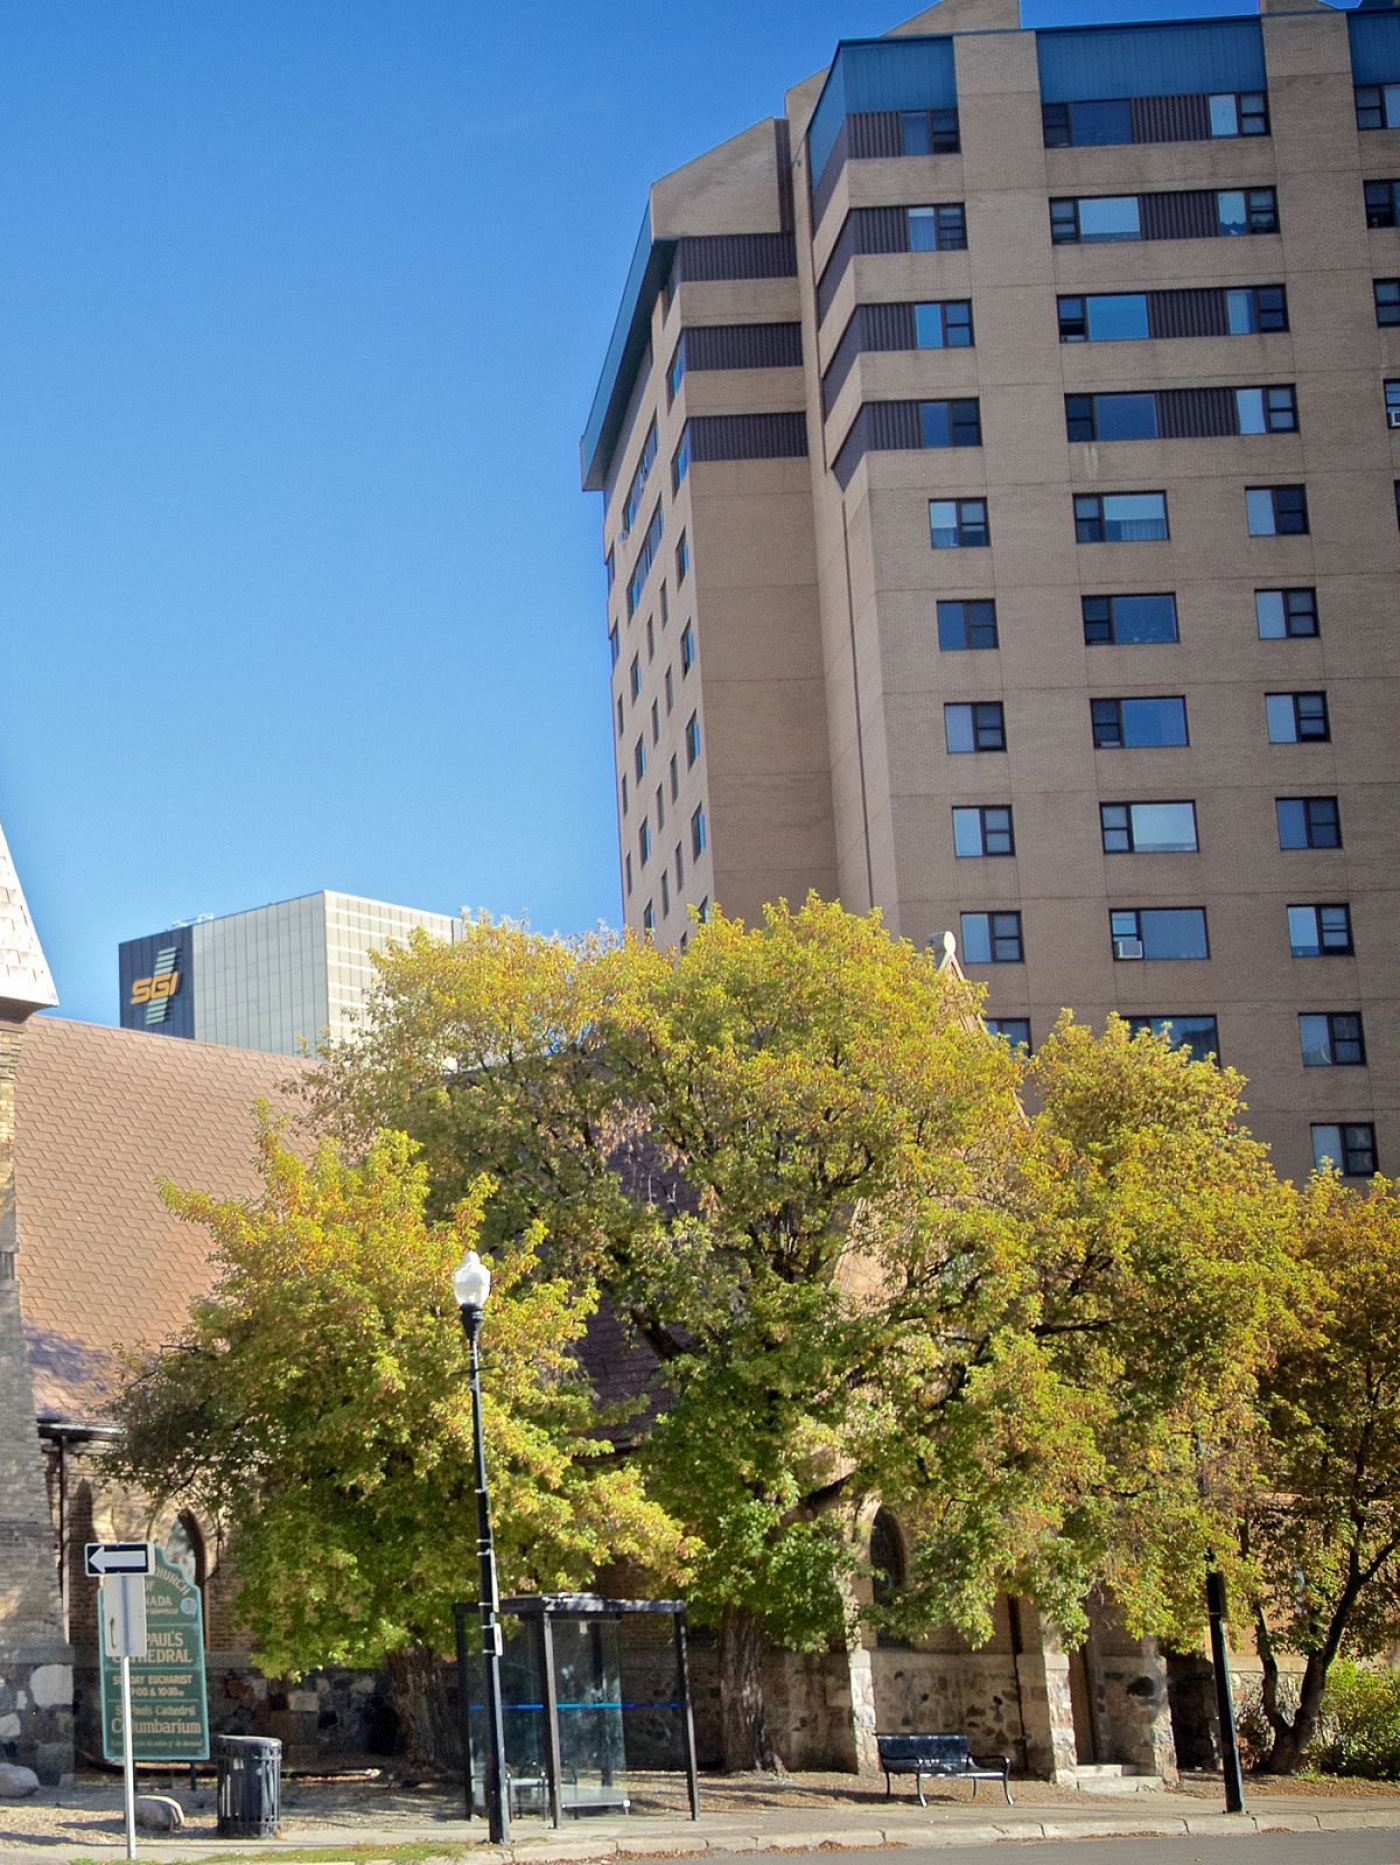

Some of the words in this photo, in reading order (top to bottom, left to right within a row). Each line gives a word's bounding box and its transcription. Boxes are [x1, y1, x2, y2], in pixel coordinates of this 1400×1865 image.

[130, 971, 179, 1005] SGI
[154, 1567, 191, 1596] HURCH
[146, 1595, 172, 1606] ADA
[112, 1649, 192, 1663] EDRAL
[112, 1675, 145, 1685] SDAY
[147, 1674, 193, 1685] EUCHARIST
[111, 1718, 201, 1733] Clumbarium
